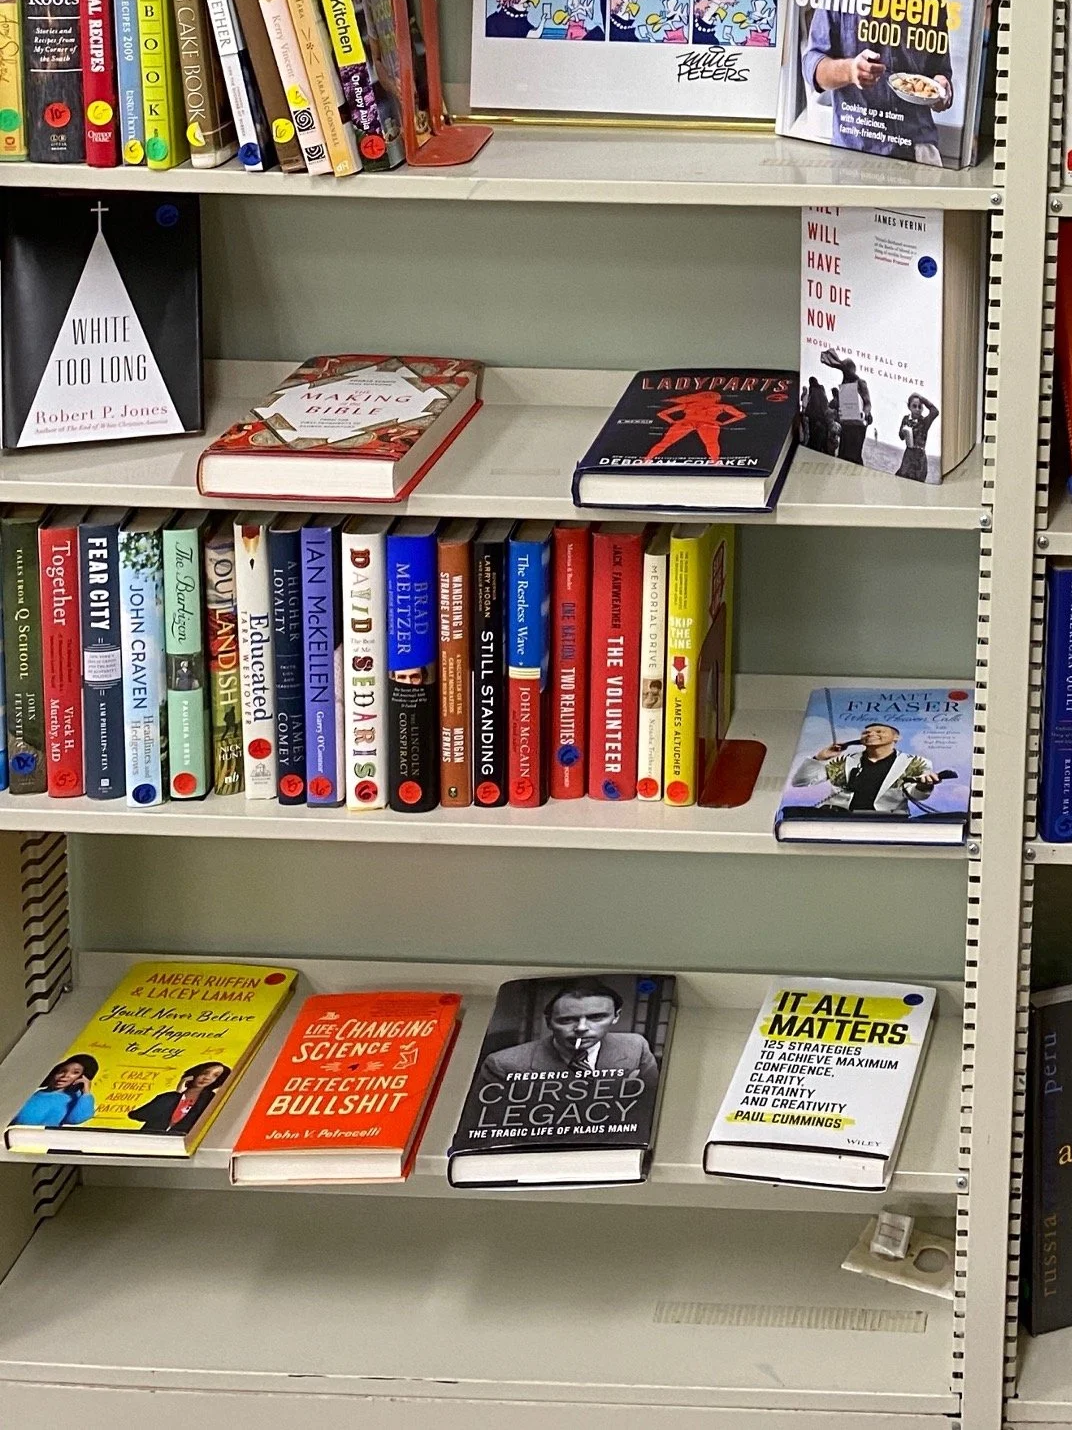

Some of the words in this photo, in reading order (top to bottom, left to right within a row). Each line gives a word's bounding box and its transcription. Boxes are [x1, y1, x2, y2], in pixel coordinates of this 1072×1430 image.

[329, 1, 352, 54] Kitchen
[857, 20, 901, 46] GOOD
[907, 27, 949, 54] FOOD
[807, 222, 839, 246] WILL
[874, 214, 897, 230] JAMES
[899, 218, 927, 232] VERINI
[807, 250, 841, 275] HAVE
[807, 279, 824, 300] TO
[829, 283, 852, 308] DIE
[72, 315, 131, 345] WHITE
[807, 309, 837, 332] NOW
[55, 359, 91, 386] TOO
[100, 354, 147, 384] LONG
[642, 375, 793, 392] LADYPARTS
[35, 405, 95, 425] Robert
[101, 405, 115, 419] P.
[120, 402, 168, 418] Jones
[88, 537, 108, 585] FEAR
[45, 540, 73, 626] Together
[89, 590, 110, 630] CITY
[608, 636, 624, 664] THE
[249, 613, 273, 722] Educated
[845, 700, 962, 714] FRASER
[604, 668, 624, 774] VOLUNTEER
[147, 986, 199, 1000] LACEY
[201, 989, 256, 1003] LAMAR
[776, 991, 807, 1013] IT
[813, 994, 871, 1019] ALL
[302, 1019, 439, 1040] LIFE-CHANGING
[767, 1015, 910, 1045] MATTERS
[291, 1042, 391, 1064] SCIENCE
[283, 1075, 408, 1091] DETECTING
[506, 1071, 571, 1081] FREDERIC
[574, 1068, 625, 1078] SPOTTS
[478, 1078, 646, 1105] CURSED
[266, 1093, 408, 1117] BULLSHIT
[477, 1102, 640, 1128] LEGACY
[733, 1110, 768, 1124] PAUL
[770, 1113, 842, 1130] CUMMINGS
